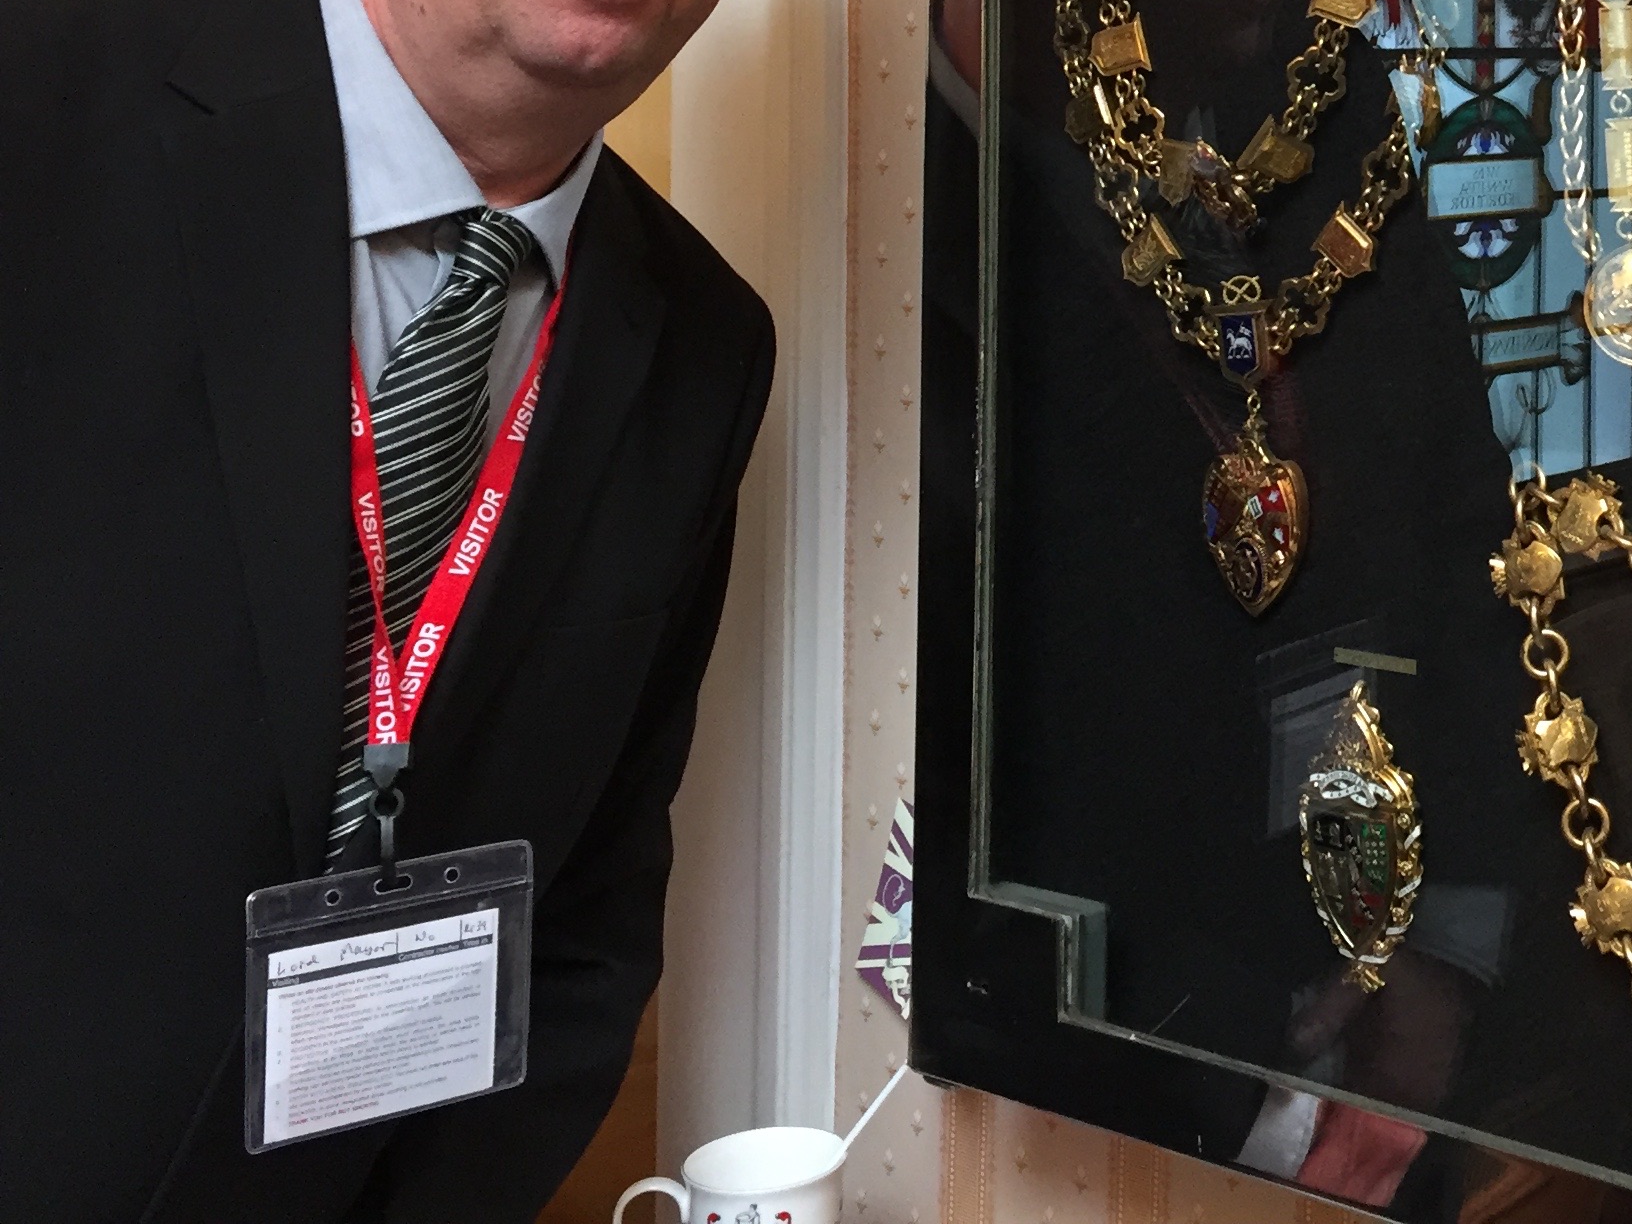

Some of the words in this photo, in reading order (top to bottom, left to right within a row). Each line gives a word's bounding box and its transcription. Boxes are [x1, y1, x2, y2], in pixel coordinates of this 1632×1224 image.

[358, 492, 386, 592] VISITOR
[448, 488, 503, 576] VISITOR
[277, 954, 320, 976] Lord
